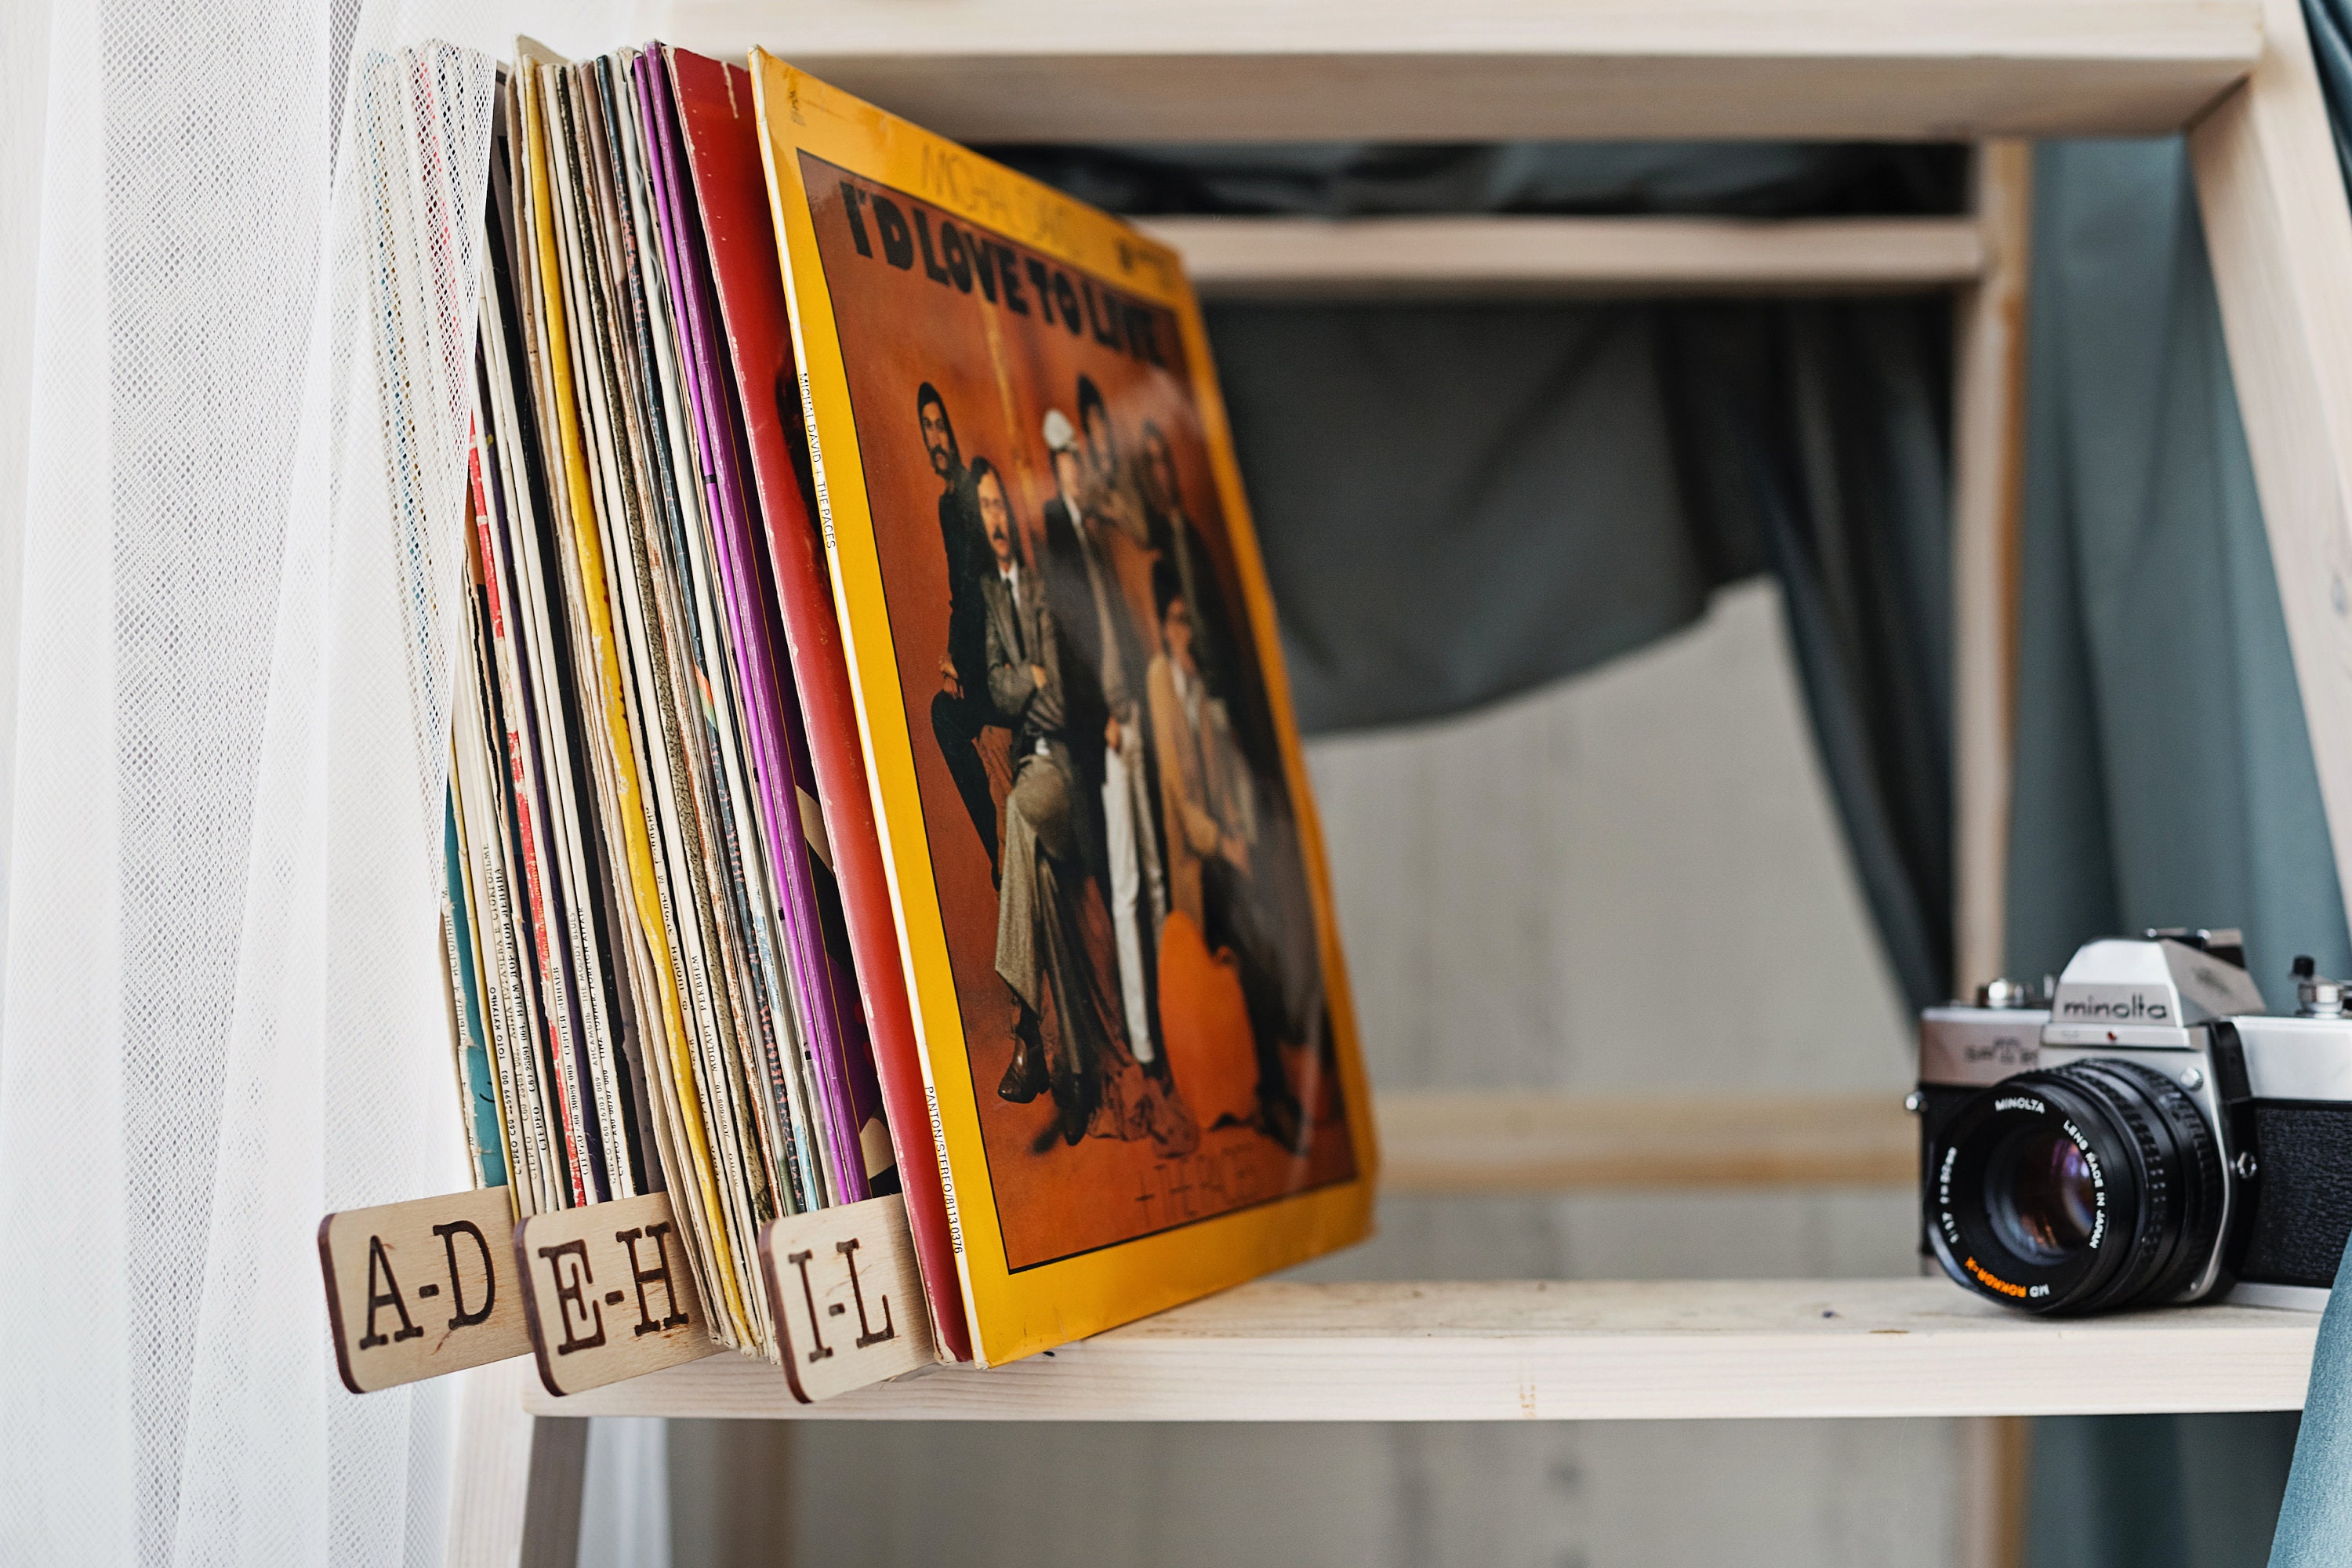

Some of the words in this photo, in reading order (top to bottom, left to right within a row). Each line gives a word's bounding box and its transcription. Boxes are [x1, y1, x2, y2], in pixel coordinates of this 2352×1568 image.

[840, 180, 914, 271] I'D
[912, 207, 1031, 315] LOVE
[1025, 256, 1083, 336] TO
[797, 372, 815, 422] MICHAL
[806, 423, 822, 463] DAVID
[815, 481, 829, 505] THE
[820, 508, 837, 548] PACES
[493, 868, 508, 918] ЛЕНИНА
[572, 944, 584, 982] MOODY
[691, 955, 706, 1010] РЕКВИЕМ
[489, 986, 500, 1029] КУТУНЬО
[2063, 993, 2168, 1019] minolta
[496, 1034, 505, 1059] ТОТО
[557, 1015, 571, 1055] СЕРГЕЙ
[584, 1012, 598, 1066] АНСАМБЛЬ
[504, 1089, 513, 1114] 599
[593, 1076, 602, 1091] 009
[597, 1096, 607, 1122] 26203
[1994, 1097, 2045, 1114] MINOLTA
[532, 1106, 546, 1151] СТЕРЕО
[601, 1126, 610, 1143] С60
[2063, 1120, 2089, 1151] LENS
[924, 1086, 958, 1224] PANTON/STEREO/8113
[949, 1226, 963, 1253] 0376
[2085, 1152, 2104, 1189] MADE
[2096, 1192, 2106, 1207] IN
[2089, 1209, 2106, 1249] JAPAN
[359, 1219, 495, 1350] A-D
[539, 1221, 690, 1356] E-H
[1965, 1256, 2027, 1298] ROKKOR-X
[2029, 1283, 2050, 1298] MD
[789, 1238, 896, 1363] I-L
